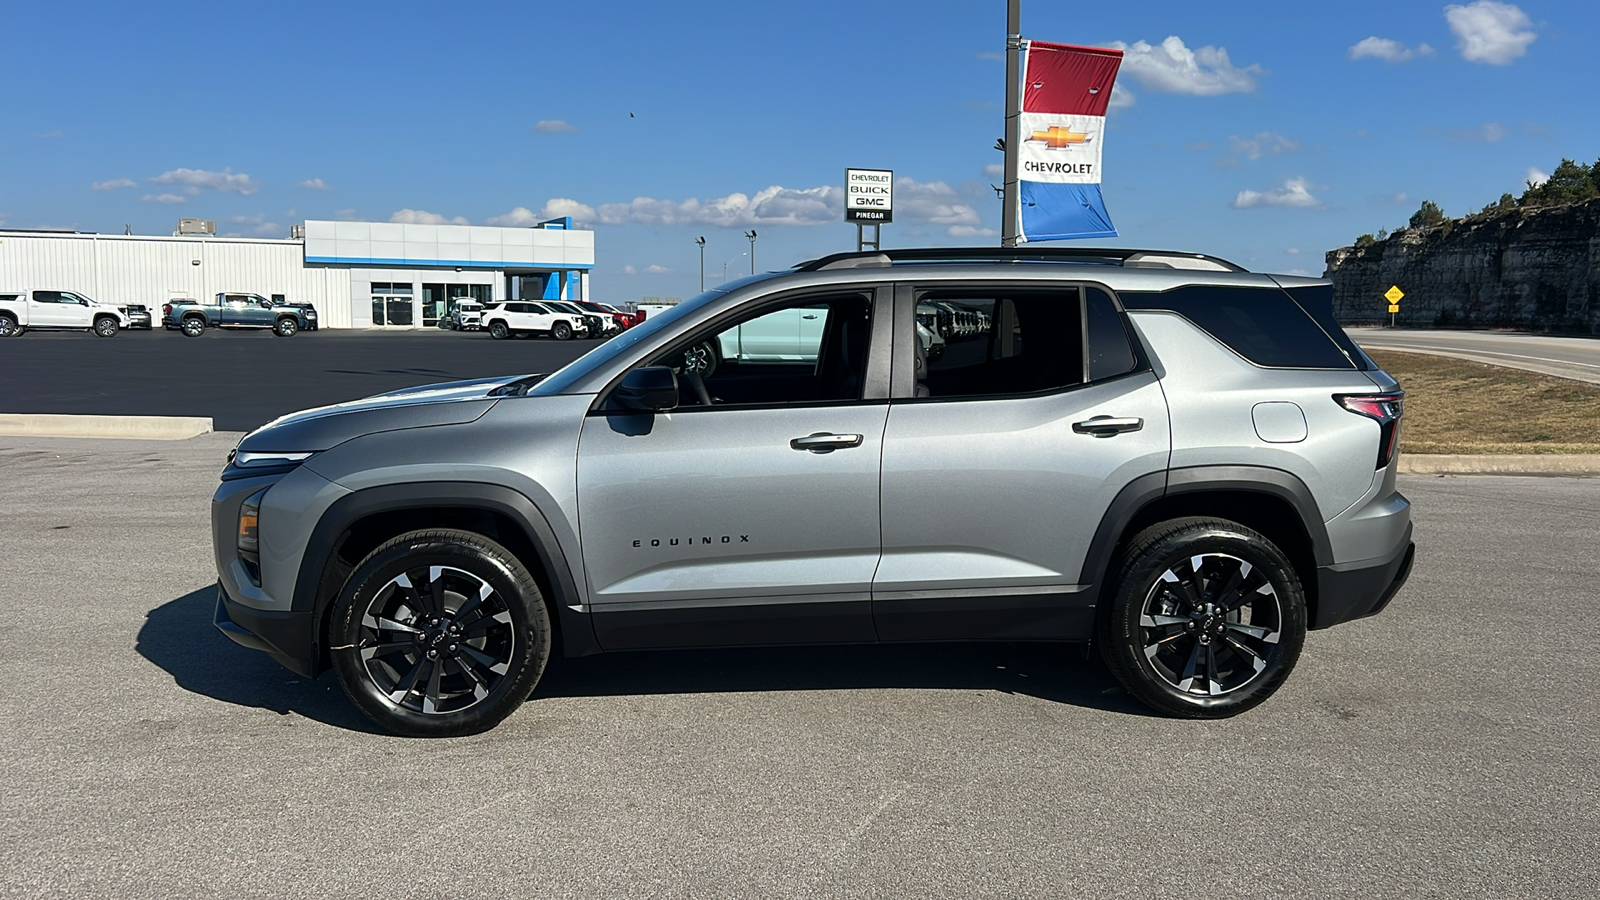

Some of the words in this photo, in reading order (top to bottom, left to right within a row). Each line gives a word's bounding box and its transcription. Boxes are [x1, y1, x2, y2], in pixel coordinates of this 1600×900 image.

[1025, 161, 1092, 174] CHEVROLET
[851, 174, 889, 182] CHEVROLET
[850, 185, 889, 194] BUICK
[856, 197, 884, 206] GMC
[856, 211, 884, 219] PINEGAR
[632, 534, 749, 548] EQUINOX
